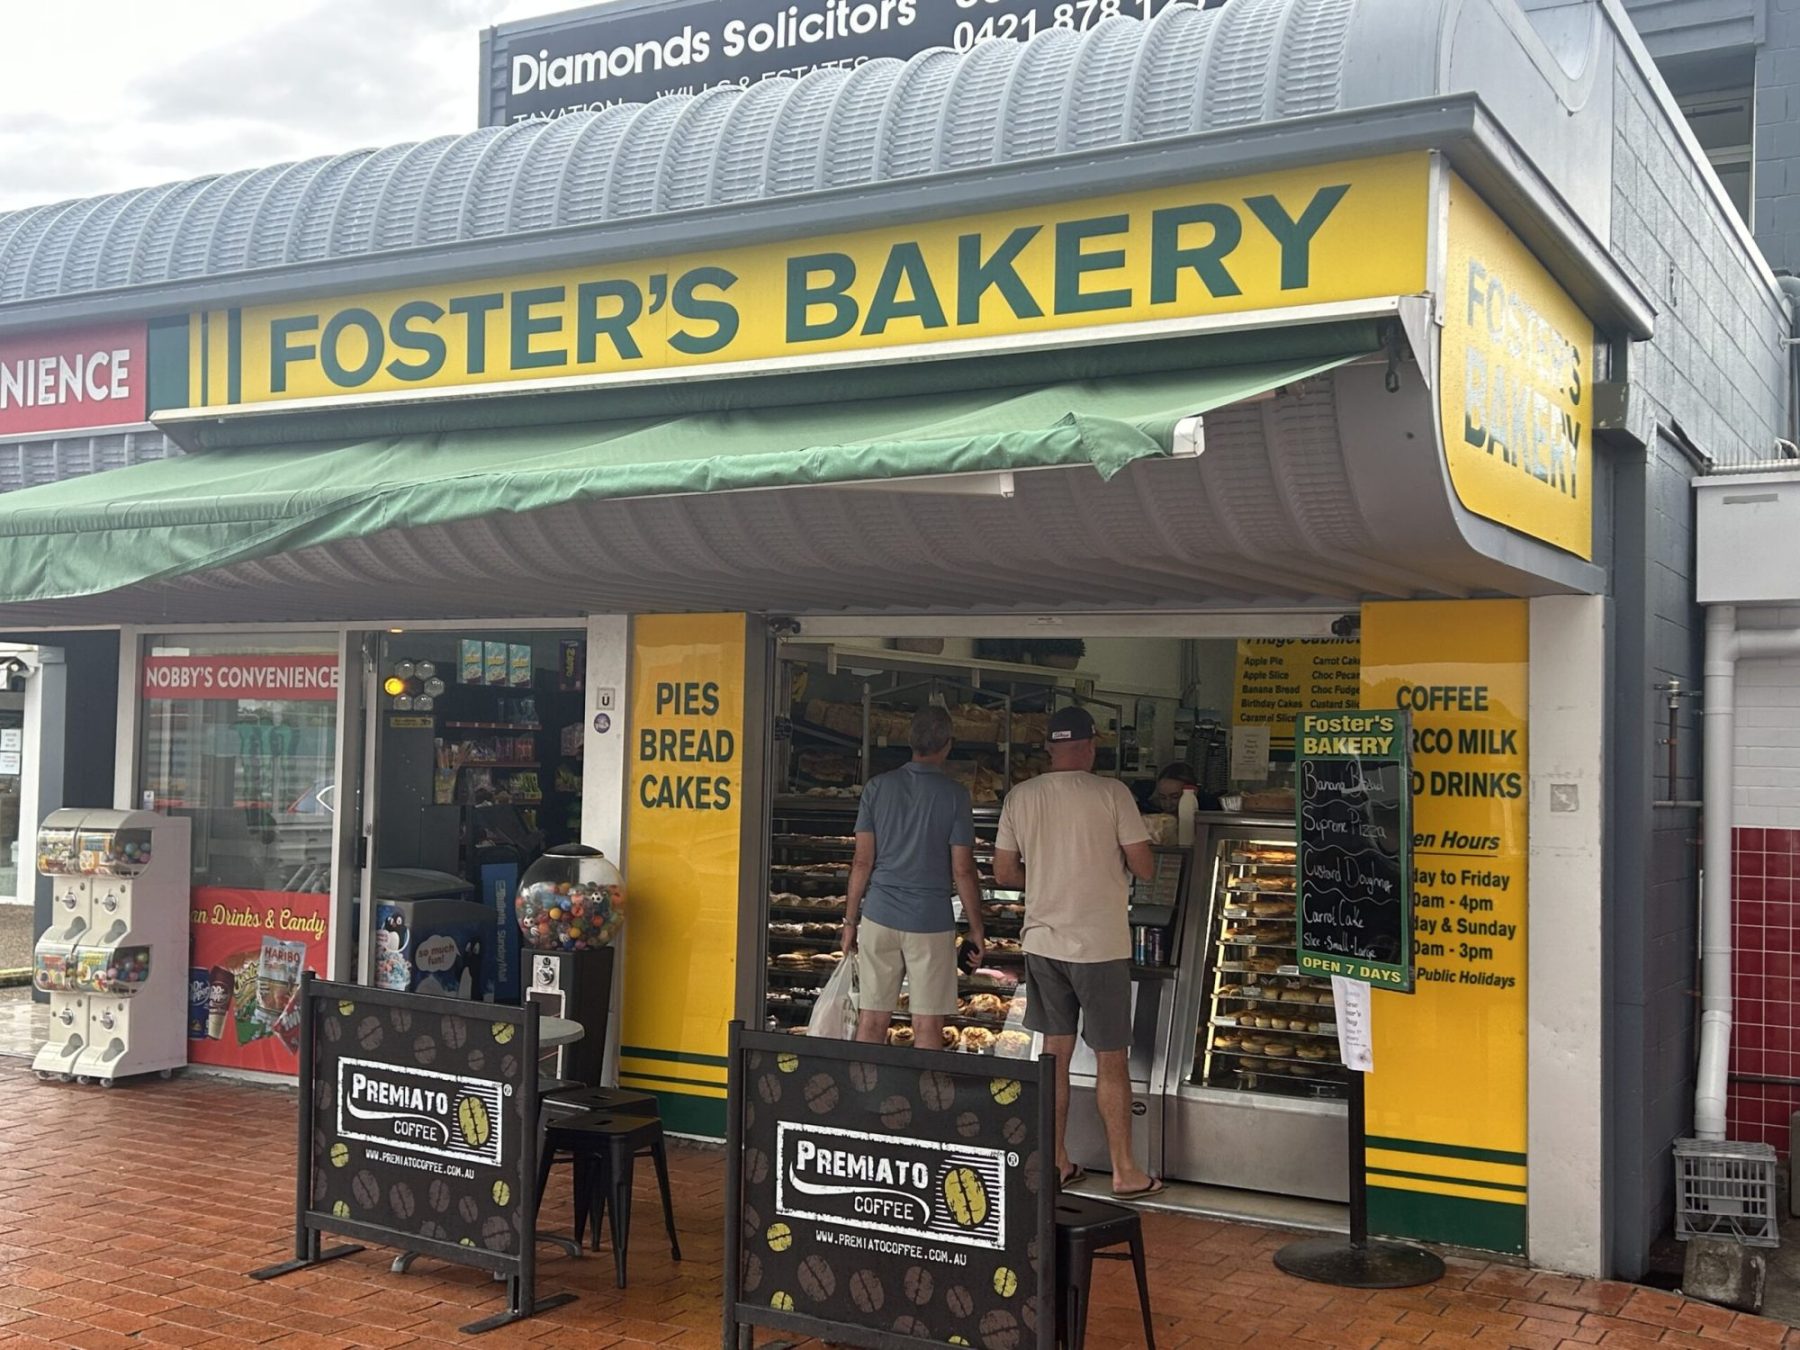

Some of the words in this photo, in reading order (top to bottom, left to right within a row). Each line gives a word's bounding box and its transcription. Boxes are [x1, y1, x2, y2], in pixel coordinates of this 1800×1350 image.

[953, 9, 1036, 53] 0421
[512, 25, 710, 96] Diamonds
[721, 0, 917, 57] Solicitors
[270, 266, 740, 393] FOSTER'S
[785, 184, 1352, 343] BAKERY
[0, 349, 130, 409] NIENCE
[1465, 346, 1581, 499] BAKERY
[146, 666, 213, 687] NOBBY'S
[217, 666, 339, 688] CONVENIENCE
[656, 682, 720, 715] PIES
[1396, 685, 1488, 712] COFFEE
[1304, 715, 1394, 733] Foster's
[640, 728, 734, 762] BREAD
[1303, 736, 1394, 754] BAKERY
[1459, 728, 1518, 755] MILK
[640, 774, 731, 810] CAKES
[1430, 771, 1522, 799] DRINKS
[1347, 807, 1387, 839] Pizza
[1441, 830, 1500, 850] Hours
[1304, 848, 1341, 882] Custard
[1441, 870, 1457, 885] to
[1461, 869, 1510, 891] Friday
[1459, 894, 1494, 914] 4pm
[211, 904, 262, 928] Drinks
[265, 909, 275, 929] &
[279, 908, 326, 941] Candy
[1441, 917, 1452, 933] &
[1457, 917, 1516, 940] Sunday
[264, 946, 300, 964] HARIBO
[1459, 942, 1494, 962] 3pm
[1303, 956, 1340, 973] OPEN
[1346, 964, 1354, 975] 7
[1360, 965, 1402, 983] DAYS
[1417, 967, 1456, 983] Public
[1459, 970, 1516, 988] Holidays
[352, 1073, 448, 1115] PREMIATO
[394, 1120, 438, 1142] COFFEE
[365, 1148, 475, 1179] WWW.PREMIATOCOFFEE.COM.AU
[796, 1140, 929, 1189] PREMIATO
[854, 1196, 914, 1220] COFFEE
[815, 1230, 967, 1266] WWW.PREMIATOCOFFEE.COM.AU
